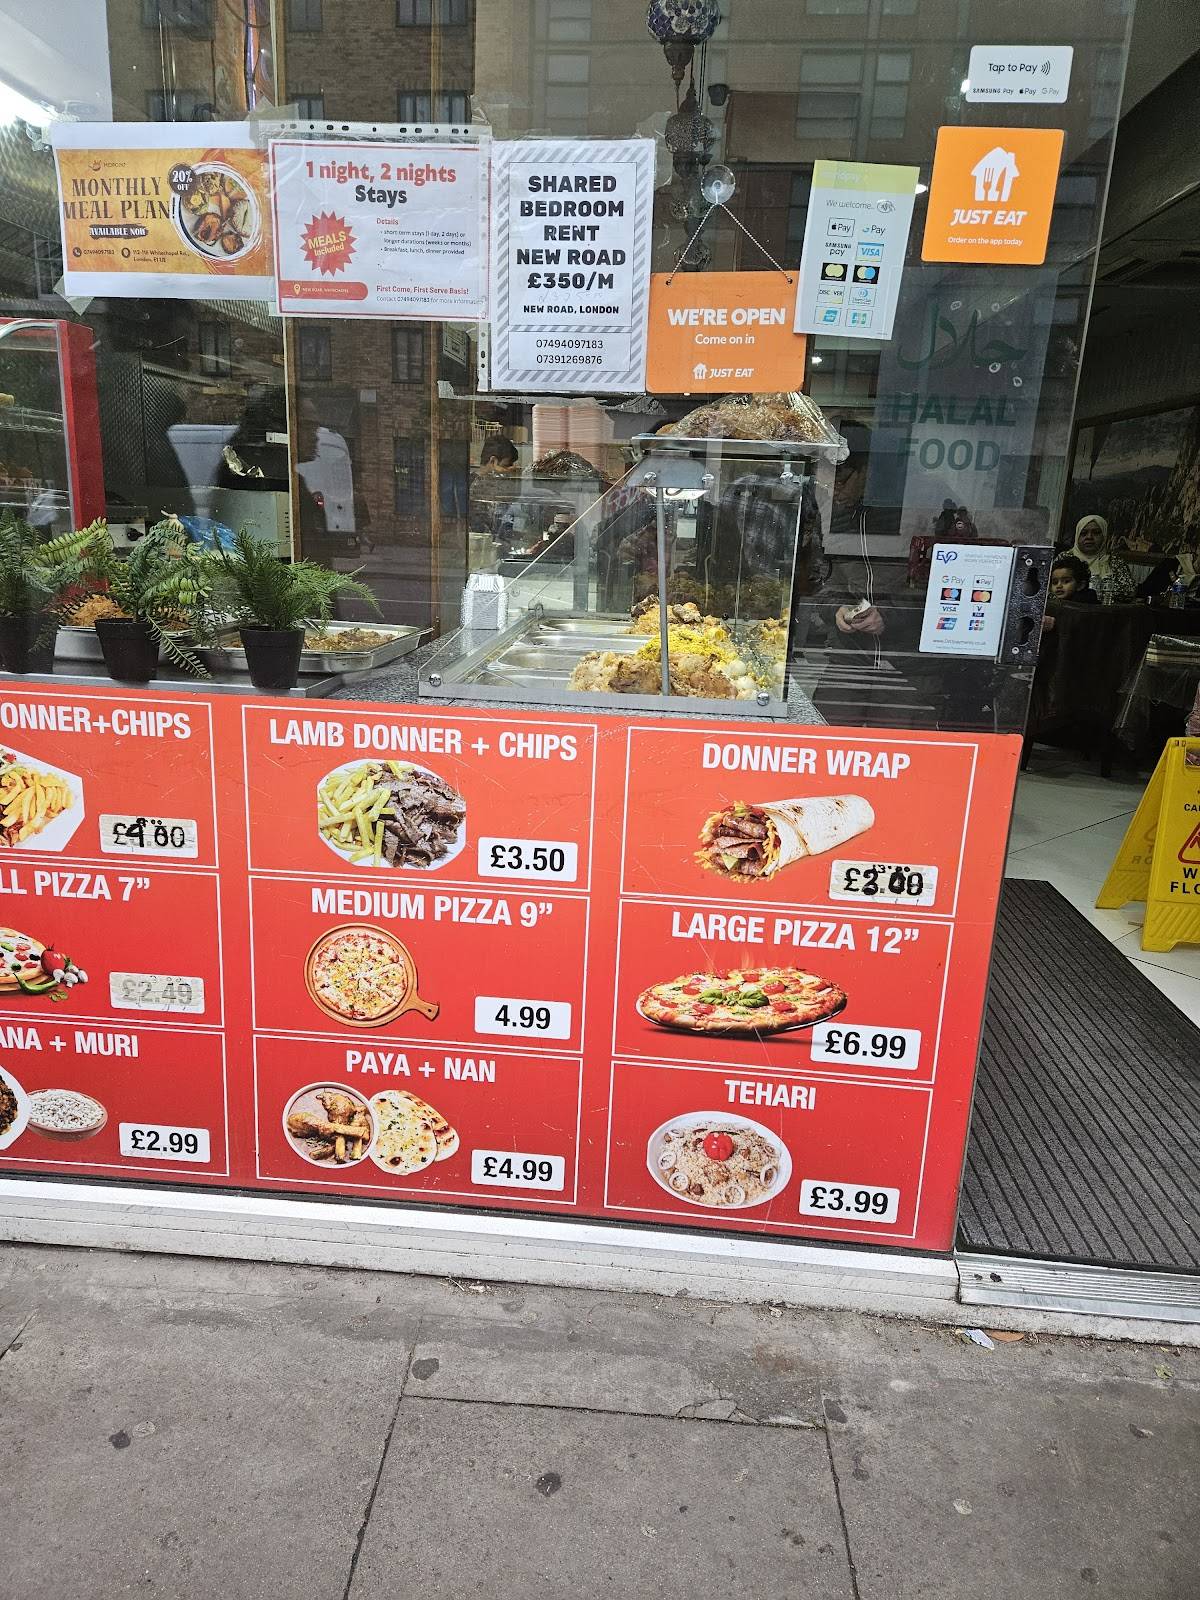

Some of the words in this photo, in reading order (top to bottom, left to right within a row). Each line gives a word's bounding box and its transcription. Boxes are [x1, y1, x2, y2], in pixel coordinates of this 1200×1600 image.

[989, 63, 1005, 73] Tap
[1008, 64, 1017, 72] to
[1019, 63, 1038, 74] Pay
[172, 170, 193, 184] 20%
[306, 161, 314, 178] 1
[319, 160, 374, 183] night,
[381, 163, 391, 179] 2
[396, 163, 456, 186] nights
[72, 176, 162, 197] MONTHLY
[177, 183, 189, 191] OFF
[528, 176, 617, 193] SHARED
[355, 184, 408, 208] Stays
[63, 200, 113, 220] MEAL
[520, 200, 624, 217] BEDROOM
[950, 209, 992, 226] JUST
[994, 210, 1027, 226] EAT
[89, 226, 129, 237] AVAILABLE
[130, 227, 146, 236] NOW
[544, 225, 599, 242] RENT
[838, 224, 851, 232] Pay
[871, 225, 886, 235] Pay
[308, 231, 347, 249] MEALS
[978, 237, 989, 245] the
[990, 238, 1002, 246] app
[1004, 238, 1023, 246] today
[314, 243, 344, 256] Included
[516, 249, 561, 265] NEW
[567, 249, 626, 266] ROAD
[861, 248, 880, 256] VISA
[376, 285, 391, 293] First
[528, 272, 614, 290] £350/M
[523, 305, 545, 314] NEW
[547, 305, 577, 315] ROAD,
[579, 305, 619, 315] LONDON
[668, 308, 727, 327] WE'RE
[731, 308, 786, 326] OPEN
[536, 339, 603, 350] 07494097183
[695, 334, 726, 345] Come
[729, 336, 742, 344] on
[745, 333, 755, 344] in
[536, 354, 602, 365] 07391269876
[709, 368, 733, 379] JUST
[735, 368, 754, 378] EAT
[894, 392, 1016, 426] HALAL
[898, 438, 1001, 471] FOOD
[936, 551, 958, 564] EVO
[951, 576, 966, 586] Pay
[270, 719, 344, 748] LAMB
[354, 723, 462, 754] DONNER
[471, 737, 490, 755] +
[498, 732, 577, 761] CHIPS
[702, 743, 816, 774] DONNER
[827, 750, 911, 779] WRAP
[1184, 803, 1200, 812] CA
[489, 845, 565, 872] £3.50
[34, 870, 112, 901] PIZZA
[311, 888, 424, 920] MEDIUM
[434, 897, 512, 927] PIZZA
[671, 912, 764, 944] LARGE
[774, 918, 855, 951] PIZZA
[494, 1004, 551, 1030] 4.99
[49, 1035, 67, 1052] +
[74, 1031, 139, 1057] MURI
[825, 1030, 907, 1059] £6.99
[345, 1050, 410, 1076] PAYA
[418, 1061, 436, 1078] +
[444, 1057, 496, 1083] NAN
[724, 1080, 816, 1110] TEHARI
[130, 1129, 198, 1154] £2.99
[483, 1156, 553, 1182] £4.99
[809, 1186, 888, 1215] £3.99
